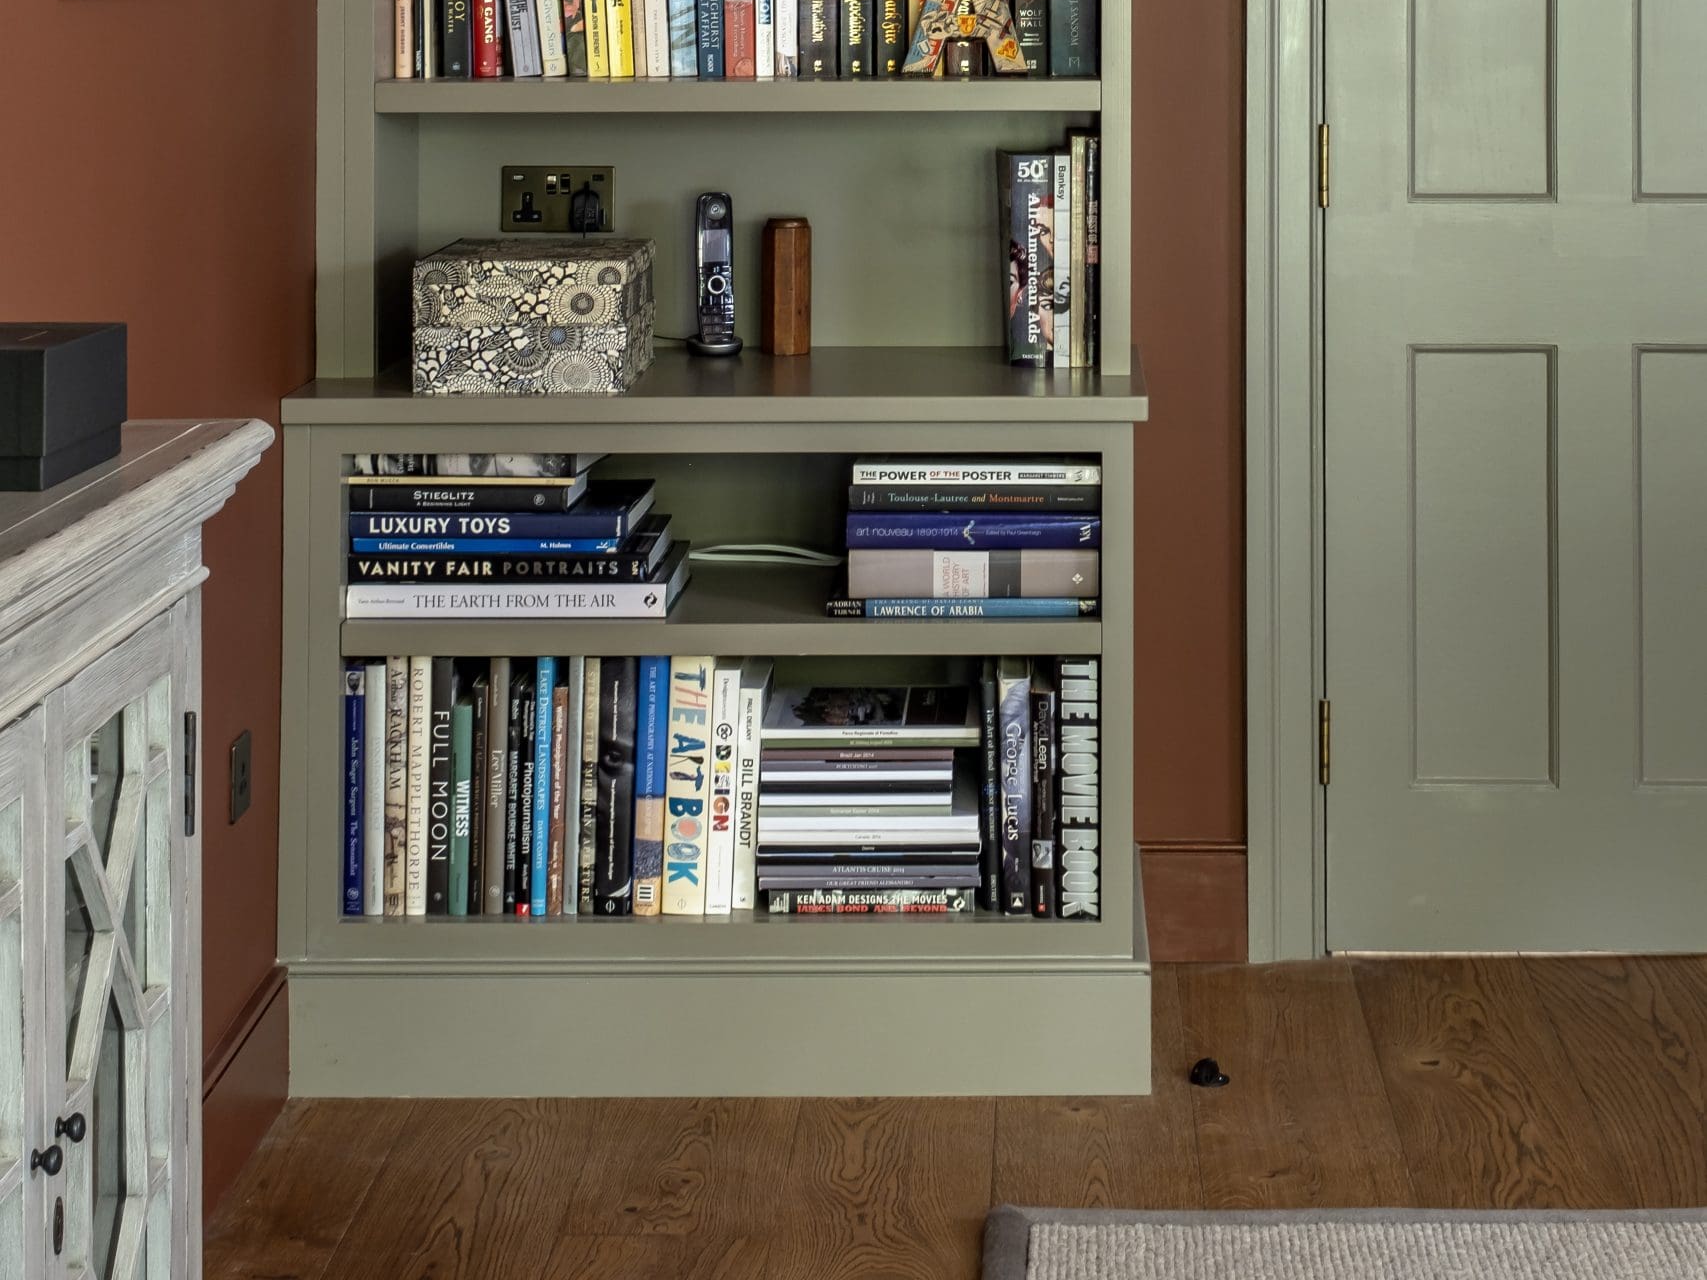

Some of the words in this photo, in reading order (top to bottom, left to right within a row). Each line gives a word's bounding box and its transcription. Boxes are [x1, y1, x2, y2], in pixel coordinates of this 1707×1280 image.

[484, 7, 493, 43] GANG
[701, 11, 709, 48] AFFAIR
[1070, 7, 1078, 45] SANSOM
[1057, 165, 1067, 200] Banksy
[1027, 194, 1041, 306] All-American
[1027, 311, 1040, 343] Ads
[413, 491, 474, 500] STIEGLITZ
[879, 471, 927, 480] POWER
[962, 471, 1011, 480] POSTER
[971, 494, 985, 502] and
[989, 494, 1044, 502] Montmartre
[369, 518, 450, 534] LUXURY
[459, 518, 510, 534] TOYS
[358, 562, 436, 576] VANITY
[447, 562, 492, 575] FAIR
[503, 561, 618, 575] PORTRAITS
[412, 595, 445, 608] THE
[450, 595, 500, 608] EARTH
[506, 594, 549, 608] FROM
[554, 594, 595, 608] THE
[592, 594, 616, 608] AIR
[874, 606, 927, 615] LAWRENCE
[931, 606, 945, 615] OF
[949, 606, 983, 616] ARABIA
[413, 668, 424, 737] ROBERT
[540, 670, 550, 694] LAKE
[672, 665, 707, 726] THE
[1061, 660, 1097, 720] THE
[432, 710, 449, 769] FULL
[538, 696, 550, 742] DISTRICT
[537, 744, 549, 810] LANDSCAPES
[669, 732, 706, 792] ART
[741, 758, 753, 787] BILL
[1005, 723, 1022, 786] George
[1062, 726, 1098, 824] MOVIE
[455, 780, 470, 837] WITNESS
[521, 762, 534, 854] Photojournalism
[713, 745, 733, 832] DESIGN
[409, 745, 422, 890] MAPPLETHORPE
[431, 781, 448, 861] MOON
[667, 797, 704, 887] BOOK
[739, 791, 752, 848] BRANDT
[1006, 794, 1023, 841] Lucas
[1061, 828, 1098, 918] BOOK
